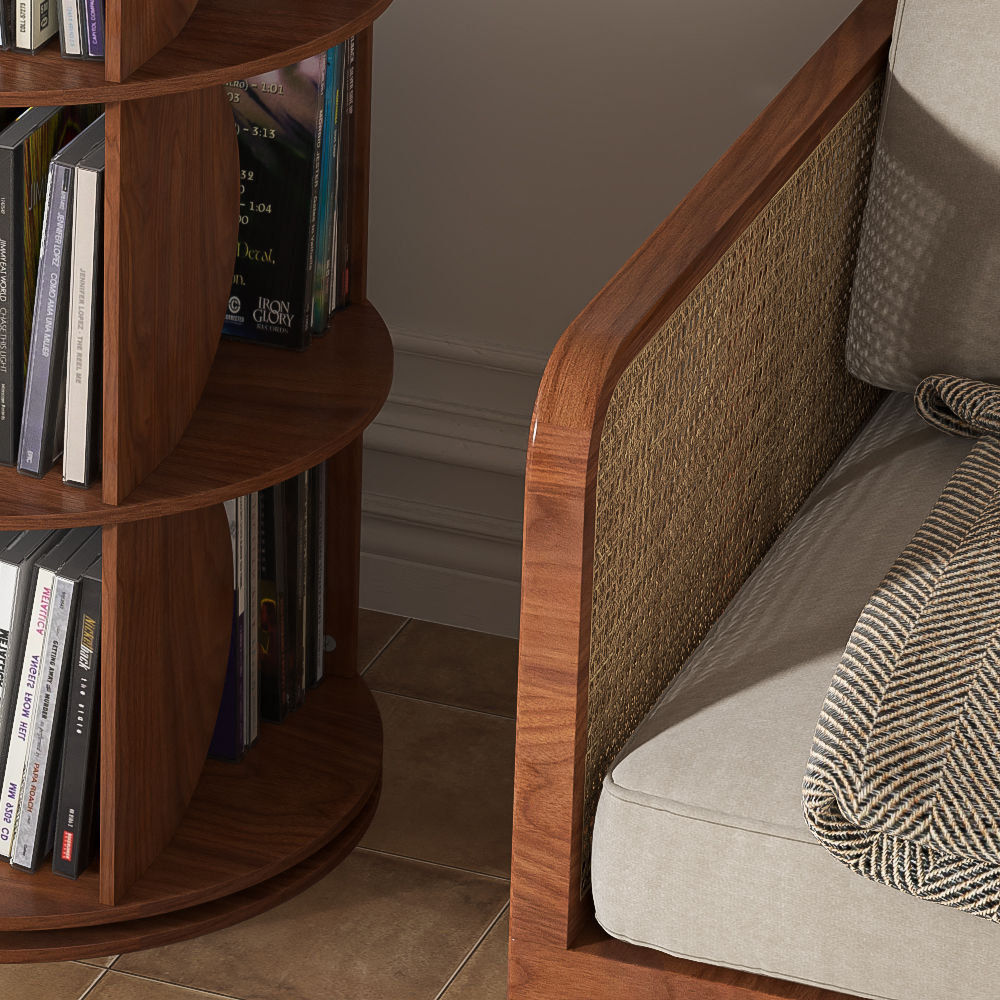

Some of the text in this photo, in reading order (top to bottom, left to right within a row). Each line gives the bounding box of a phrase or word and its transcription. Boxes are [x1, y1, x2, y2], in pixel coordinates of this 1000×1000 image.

[89, 21, 98, 45] CAPITOL
[261, 82, 285, 96] 1:01
[252, 126, 276, 139] 3:13
[240, 169, 254, 181] 32
[249, 201, 273, 214] 1:04
[53, 211, 65, 245] JENNIFER
[50, 243, 61, 267] LOPEZ
[47, 271, 58, 298] COMO
[77, 267, 86, 305] JENNIFER
[45, 297, 55, 316] AMA
[258, 296, 291, 313] IRON
[43, 316, 53, 333] UNA
[76, 305, 85, 330] LOPEZ
[252, 308, 295, 328] GLORY
[0, 332, 7, 349] THIS
[0, 349, 7, 373] LIGHT
[75, 351, 83, 371] REEL
[74, 371, 82, 385] ME
[48, 639, 59, 665] GETTING
[45, 665, 55, 684] AWAY
[78, 676, 88, 696] the
[40, 692, 51, 719] MURDER
[30, 761, 40, 782] PAPA
[25, 782, 37, 812] ROACH
